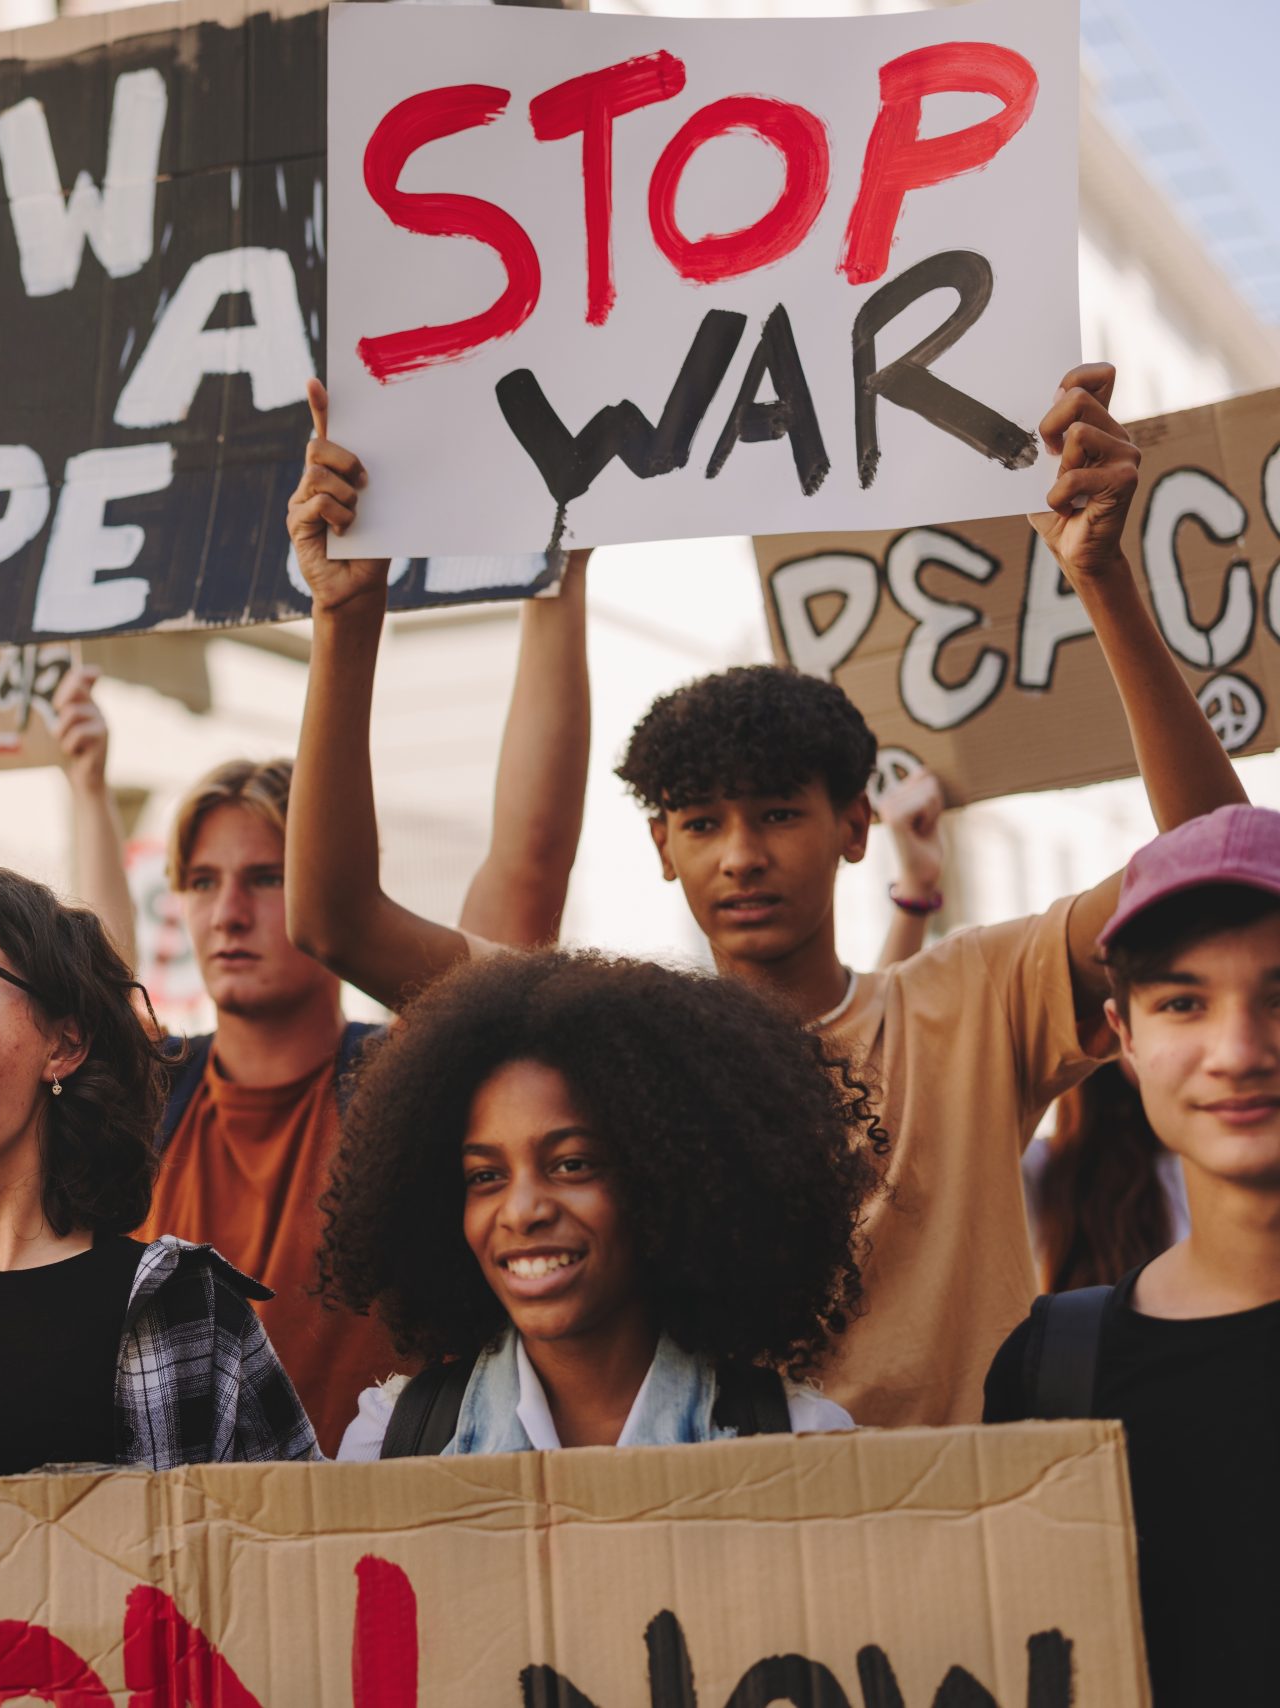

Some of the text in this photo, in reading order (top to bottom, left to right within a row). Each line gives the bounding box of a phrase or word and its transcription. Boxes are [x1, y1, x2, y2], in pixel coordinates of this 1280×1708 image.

[356, 41, 1039, 385] STOP
[495, 249, 1039, 506] WAR
[770, 440, 1280, 732] PEAC
